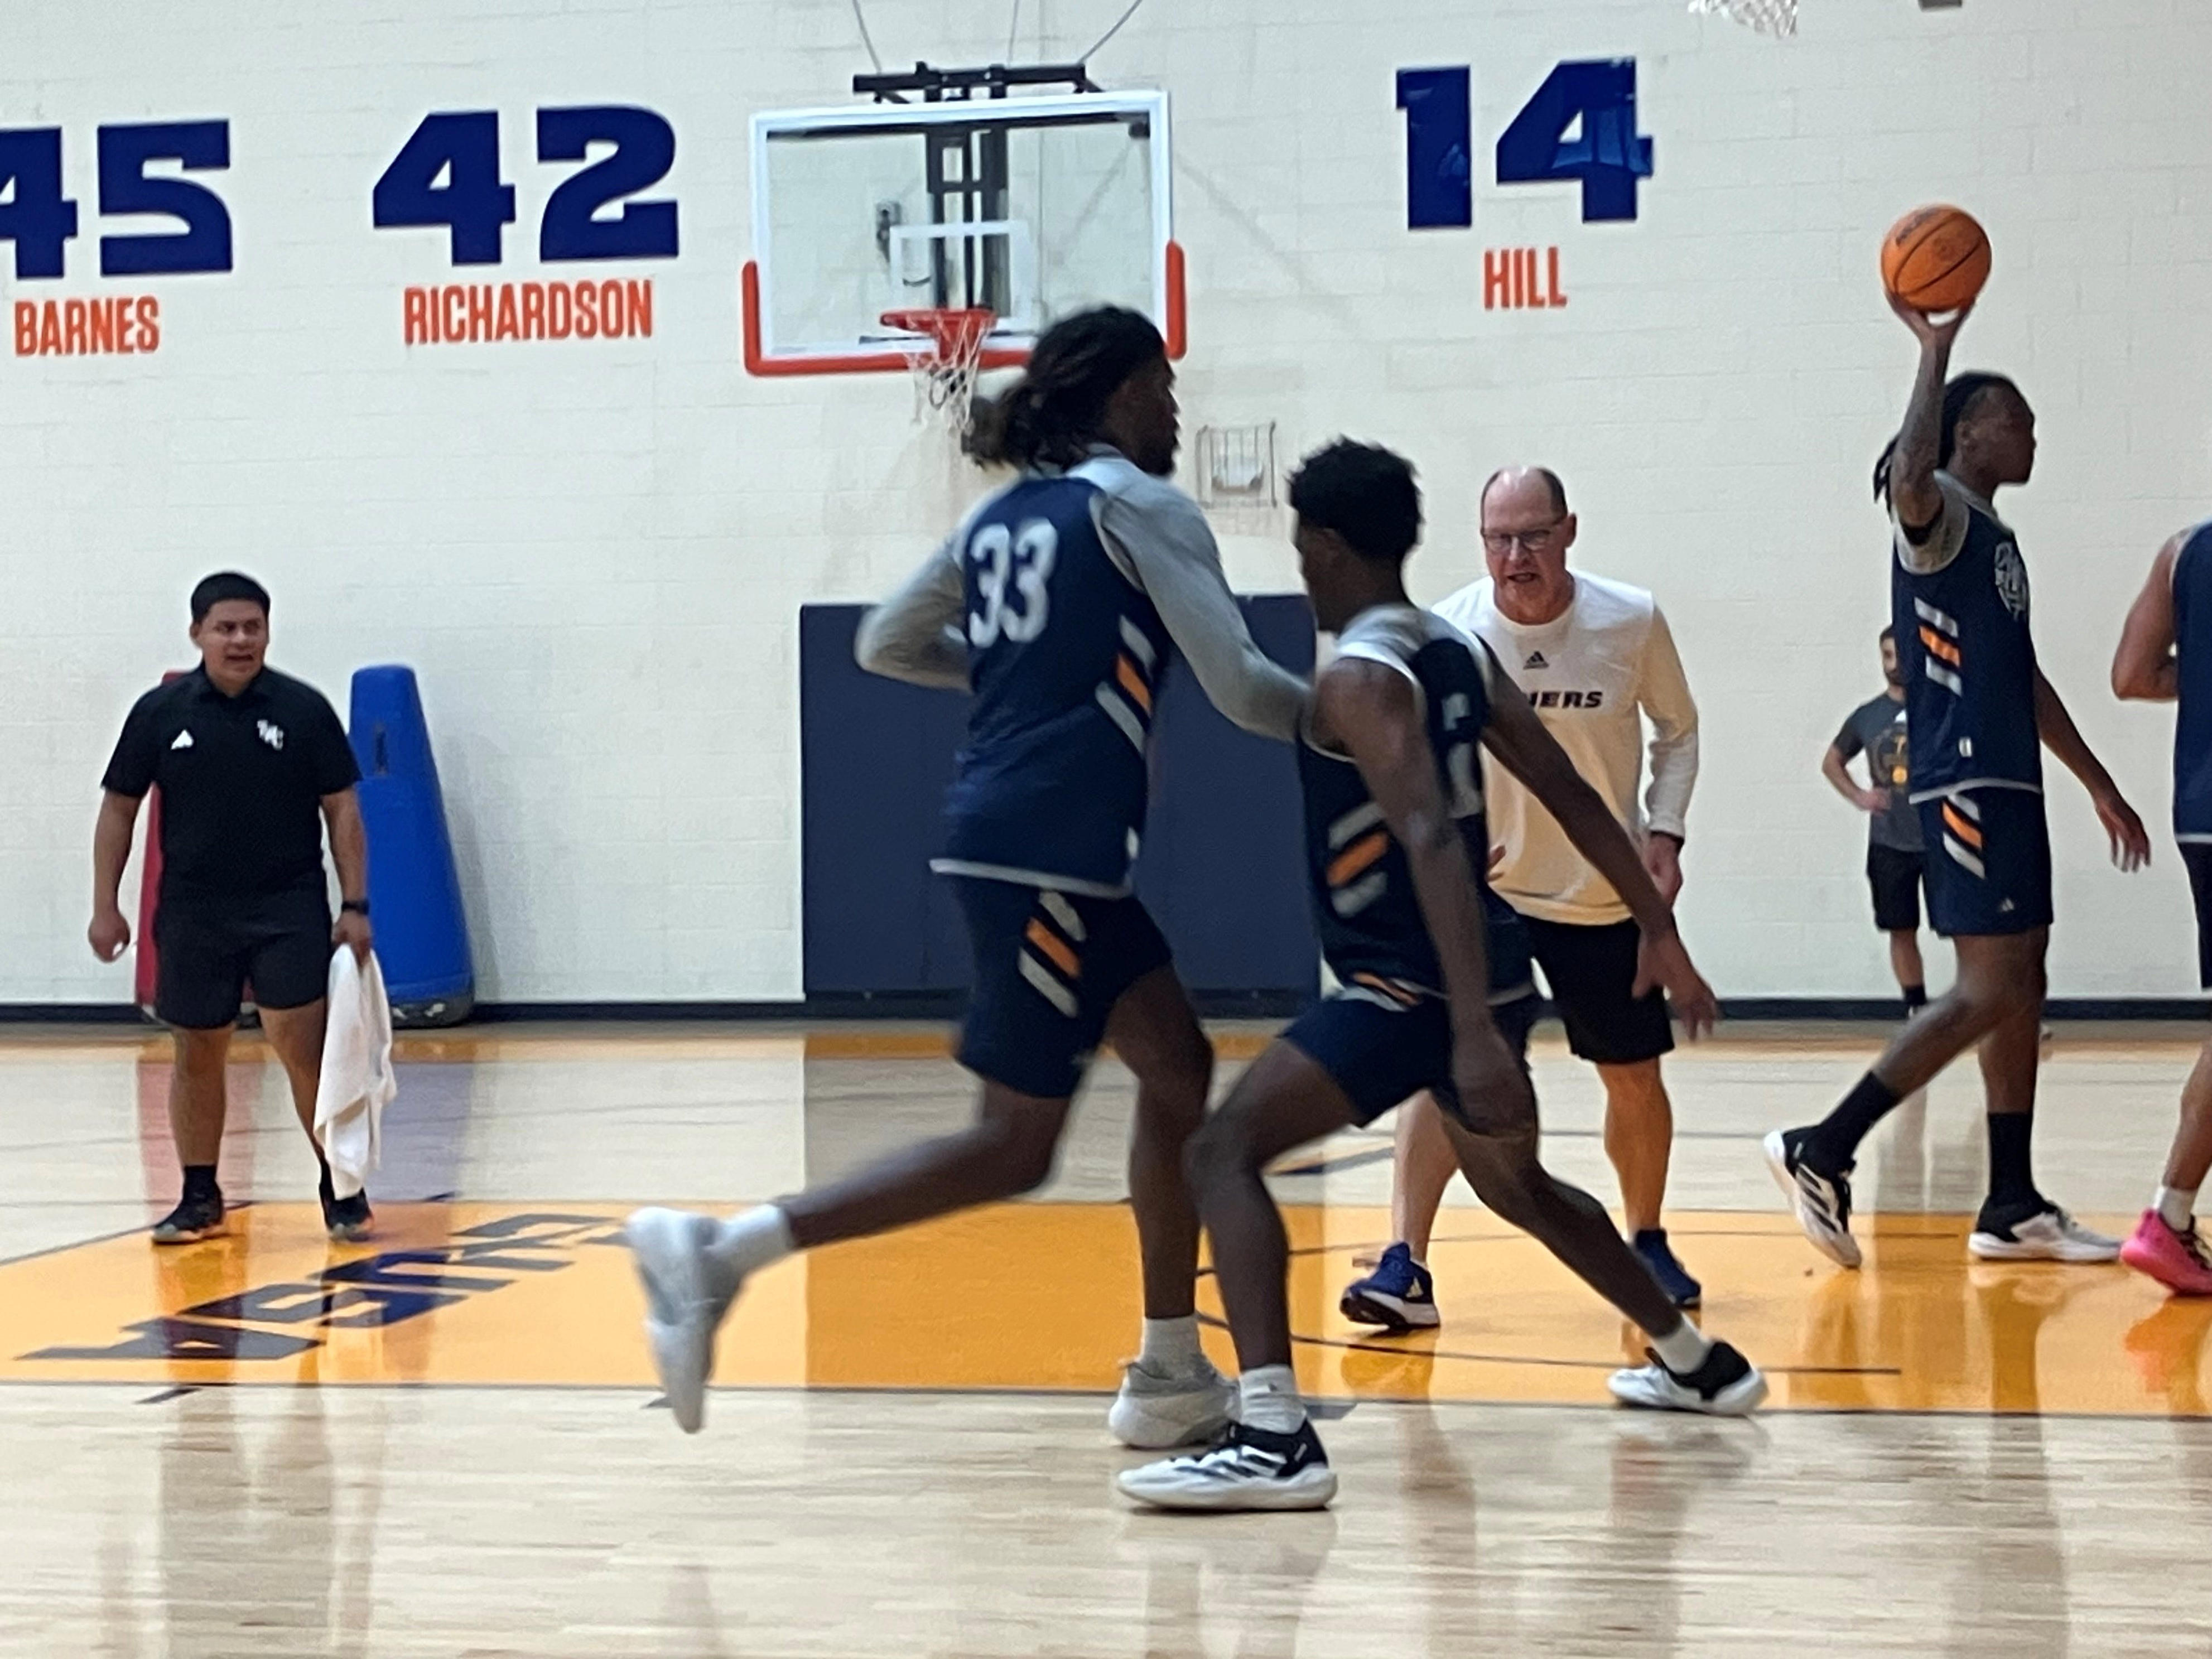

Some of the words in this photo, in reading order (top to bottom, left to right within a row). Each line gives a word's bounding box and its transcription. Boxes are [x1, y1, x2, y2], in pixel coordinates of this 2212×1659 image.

[373, 104, 679, 266] 42
[1396, 57, 1654, 230] 14
[15, 296, 160, 356] BARNES
[403, 279, 653, 345] RICHARDSON
[1483, 247, 1567, 310] HILL
[969, 517, 1058, 648] 33
